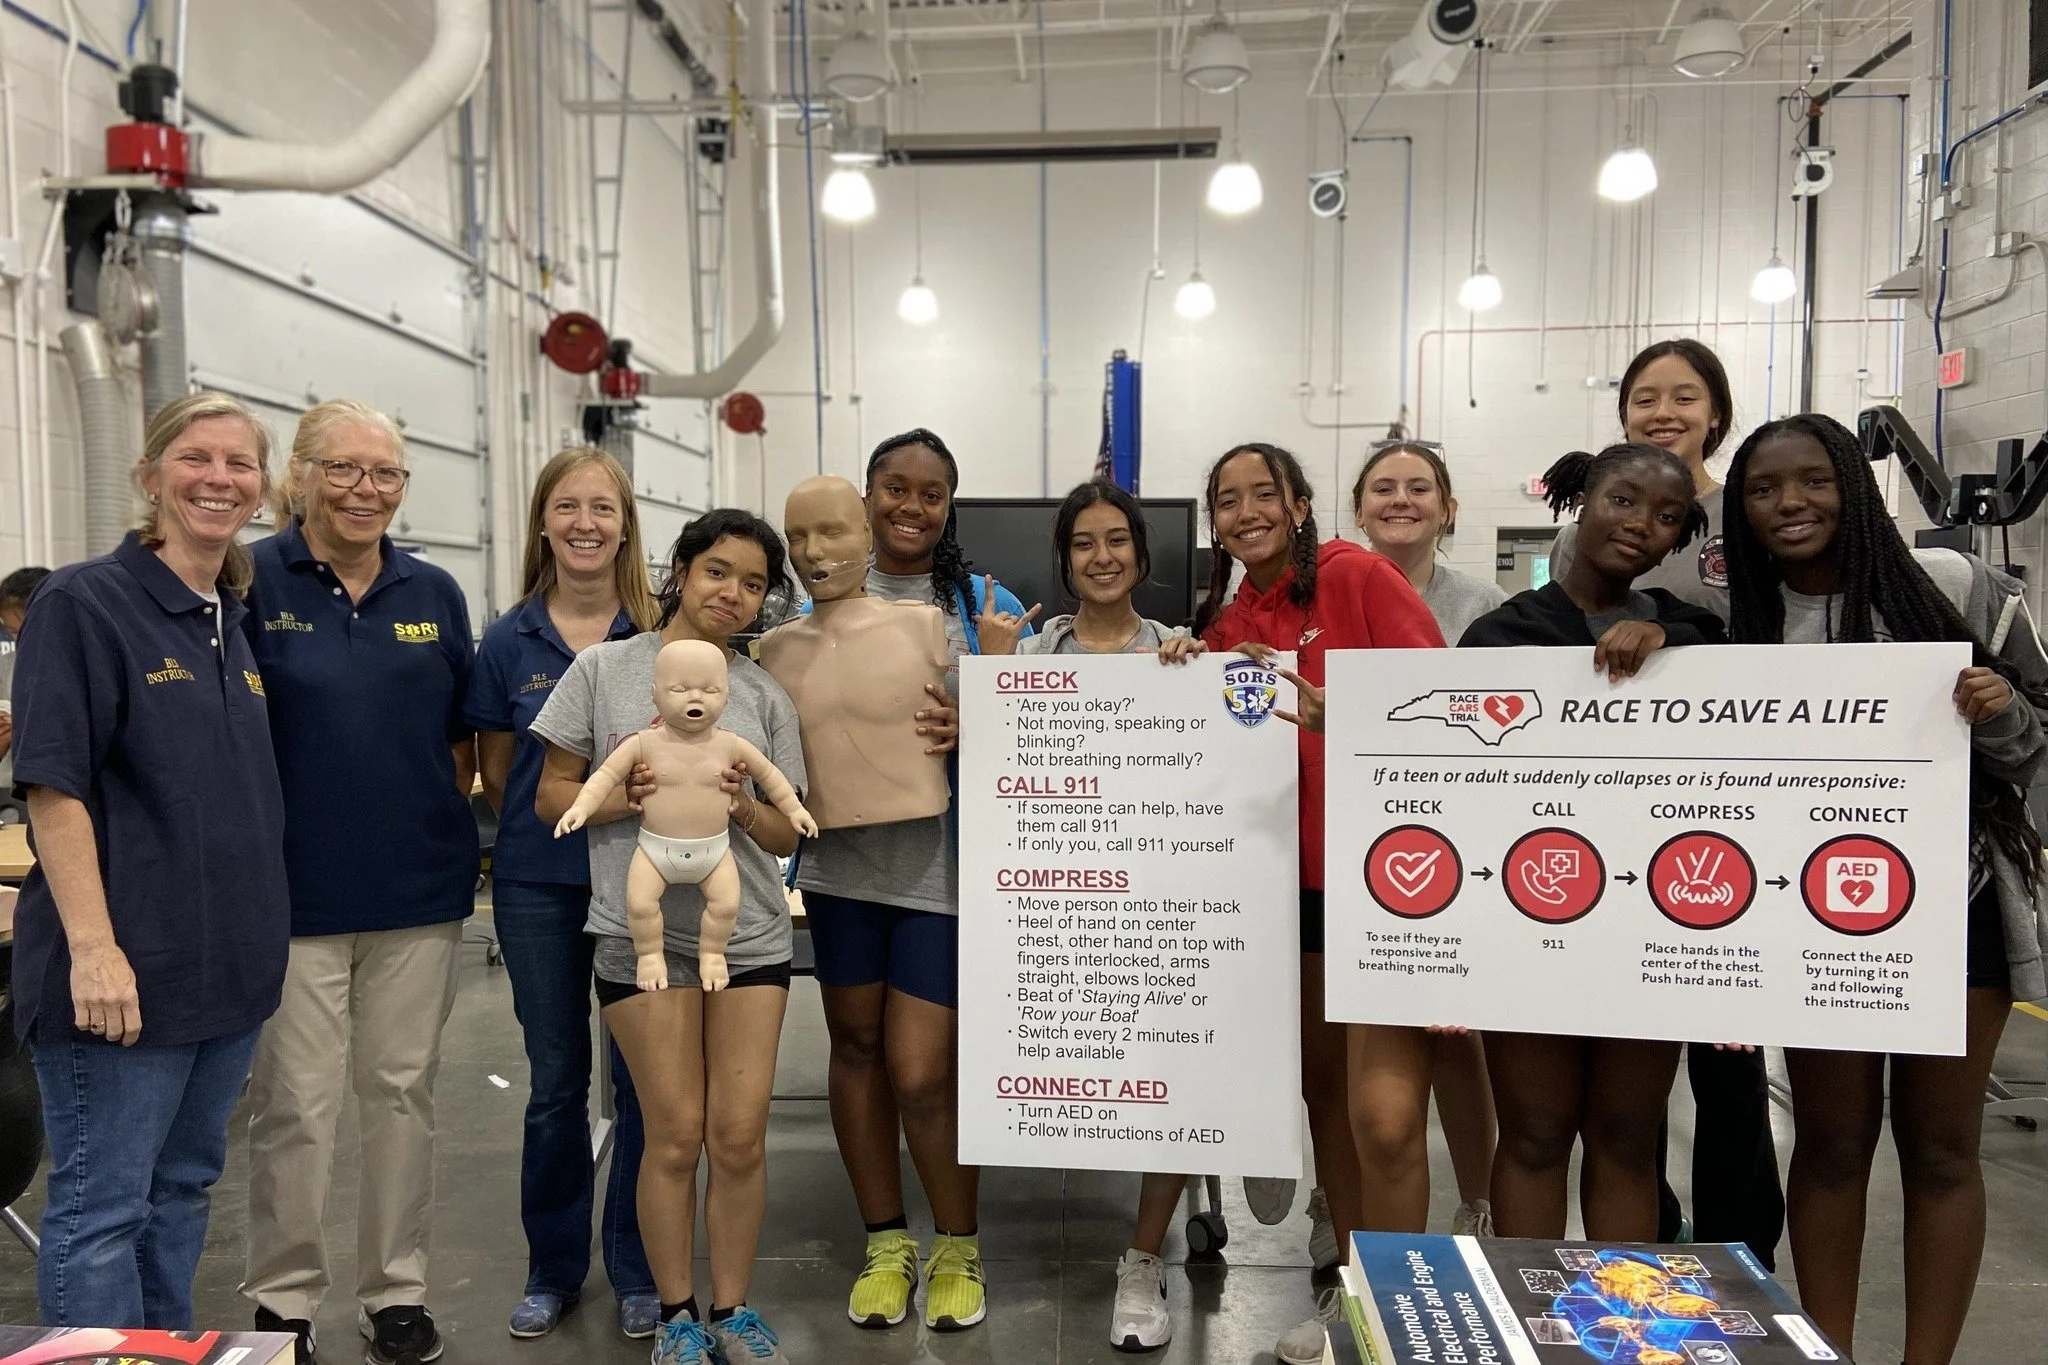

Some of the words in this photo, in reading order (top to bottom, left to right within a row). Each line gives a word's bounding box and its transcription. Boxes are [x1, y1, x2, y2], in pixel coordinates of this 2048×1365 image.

[1497, 557, 1514, 567] E103
[279, 611, 296, 621] BLS
[263, 619, 315, 632] INSTRUCTOR
[145, 668, 197, 685] INSTRUC
[531, 672, 548, 682] BLS
[996, 670, 1079, 690] CHECK
[1224, 671, 1278, 686] SORS
[519, 678, 561, 694] INSTRUCTO
[1449, 694, 1479, 704] RACE
[1449, 703, 1479, 713] CARS
[1051, 701, 1080, 716] you
[1449, 712, 1480, 722] TRIAL
[1560, 699, 1642, 724] RACE
[1649, 698, 1691, 724] TO
[1698, 698, 1782, 724] SAVE
[1787, 699, 1811, 724] A
[1821, 698, 1889, 724] LIFE
[1017, 716, 1045, 731] Not
[1049, 716, 1109, 734] moving,
[1114, 715, 1185, 734] speaking
[1190, 718, 1207, 730] or
[1017, 733, 1085, 752] blinking?
[1017, 752, 1045, 767] Not
[1049, 752, 1121, 770] breathing
[1126, 751, 1203, 770] normally?
[996, 775, 1058, 794] CALL
[1064, 776, 1099, 795] 911
[1373, 767, 1388, 786] If
[1388, 771, 1399, 782] a
[1403, 768, 1439, 783] teen
[1443, 772, 1462, 783] or
[1464, 768, 1510, 784] adult
[1512, 769, 1591, 789] suddenly
[1592, 770, 1672, 788] collapses
[1676, 774, 1697, 786] or
[1699, 771, 1714, 787] is
[1714, 771, 1773, 791] found
[1777, 773, 1906, 793] unresponsive:
[1018, 800, 1028, 814] If
[1031, 803, 1103, 815] someone
[1108, 803, 1136, 815] can
[1141, 800, 1179, 819] help,
[1185, 800, 1224, 816] have
[1384, 799, 1443, 815] CHECK
[1532, 801, 1576, 817] CALL
[1650, 803, 1756, 821] COMPRESS
[1809, 806, 1909, 824] CONNECT
[1016, 818, 1056, 833] them
[1060, 818, 1086, 833] call
[1091, 818, 1117, 833] 911
[1018, 836, 1028, 851] If
[1031, 836, 1064, 855] only
[1068, 840, 1101, 855] you,
[1106, 837, 1133, 852] call
[1137, 837, 1164, 852] 911
[1170, 837, 1235, 856] yourself
[997, 868, 1129, 889] COMPRESS
[1836, 862, 1879, 877] AED
[1017, 896, 1060, 911] Move
[1065, 900, 1118, 915] person
[1123, 898, 1158, 913] onto
[1162, 898, 1199, 913] their
[1203, 898, 1241, 914] back
[1018, 914, 1053, 929] Heel
[1057, 914, 1074, 930] of
[1077, 915, 1116, 930] hand
[1121, 919, 1141, 931] on
[1146, 917, 1197, 932] center
[1017, 932, 1063, 949] chest,
[1068, 933, 1110, 949] other
[1114, 934, 1153, 950] hand
[1157, 938, 1178, 950] on
[1182, 936, 1208, 954] top
[1212, 936, 1245, 951] with
[1365, 931, 1379, 942] To
[1381, 934, 1401, 943] see
[1403, 932, 1413, 943] if
[1413, 932, 1441, 948] they
[1443, 936, 1462, 945] are
[1542, 938, 1565, 950] 911
[1370, 947, 1432, 960] responsive
[1434, 948, 1457, 959] and
[1645, 942, 1678, 954] Place
[1681, 943, 1720, 956] hands
[1723, 945, 1735, 957] in
[1738, 945, 1760, 958] the
[1801, 949, 1857, 962] Connect
[1859, 950, 1883, 963] the
[1885, 952, 1914, 964] AED
[1016, 950, 1070, 969] fingers
[1075, 951, 1165, 970] interlocked,
[1170, 957, 1210, 969] arms
[1358, 959, 1415, 976] breathing
[1417, 963, 1470, 978] normally
[1641, 958, 1682, 969] center
[1684, 958, 1699, 970] of
[1700, 959, 1723, 971] the
[1725, 960, 1764, 973] chest.
[1017, 969, 1079, 988] straight,
[1084, 970, 1140, 986] elbows
[1144, 971, 1196, 988] locked
[1642, 972, 1672, 984] Push
[1675, 973, 1704, 986] hard
[1707, 975, 1732, 987] and
[1735, 976, 1763, 989] fast.
[1806, 963, 1823, 979] by
[1825, 965, 1876, 981] turning
[1878, 967, 1889, 979] it
[1891, 970, 1909, 979] on
[1018, 987, 1054, 1003] Beat
[1058, 988, 1074, 1003] of
[1191, 995, 1208, 1007] or
[1810, 981, 1836, 992] and
[1839, 980, 1904, 999] following
[1804, 995, 1827, 1007] the
[1830, 996, 1910, 1011] instructions
[1060, 1010, 1097, 1025] your
[1017, 1024, 1069, 1040] Switch
[1073, 1029, 1118, 1045] every
[1122, 1027, 1132, 1042] 2
[1137, 1027, 1200, 1044] minutes
[1205, 1029, 1215, 1044] if
[1018, 1042, 1051, 1061] help
[1055, 1044, 1125, 1060] available
[997, 1075, 1113, 1098] CONNECT
[1117, 1079, 1168, 1100] AED
[1017, 1102, 1053, 1119] Turn
[1056, 1104, 1093, 1120] AED
[1098, 1109, 1118, 1121] on
[1018, 1121, 1069, 1138] Follow
[1073, 1123, 1164, 1142] instructions
[1168, 1127, 1185, 1142] of
[1187, 1128, 1225, 1144] AED
[1405, 1249, 1435, 1285] Engine
[1415, 1286, 1444, 1307] and
[1393, 1293, 1436, 1364] Automotive
[1425, 1307, 1469, 1365] Electrical
[1453, 1291, 1502, 1365] Performance
